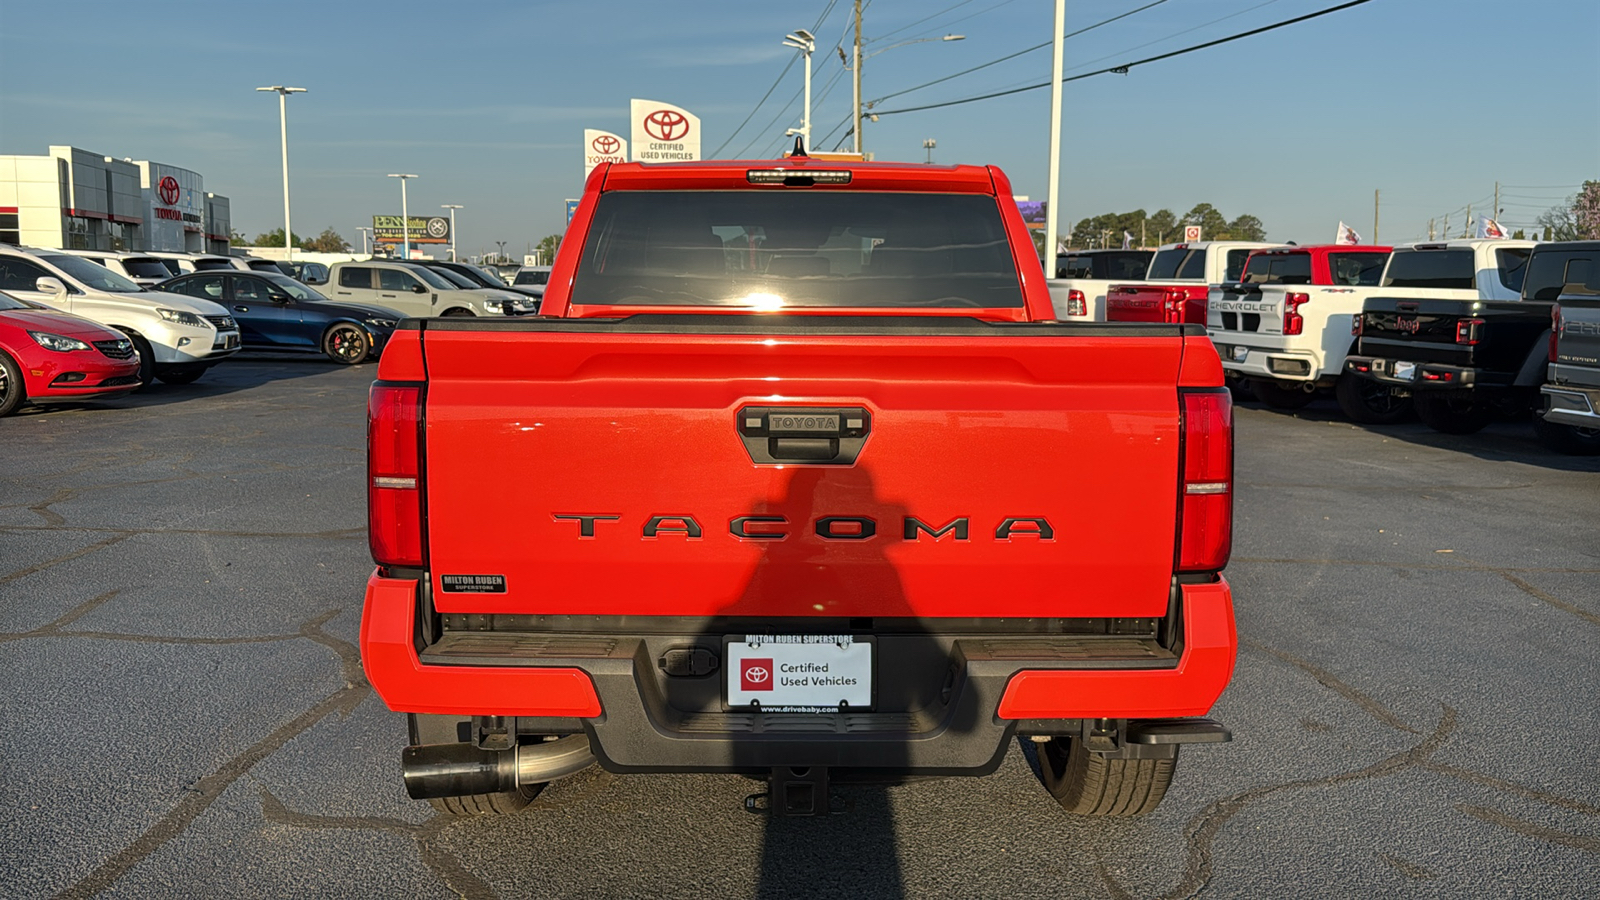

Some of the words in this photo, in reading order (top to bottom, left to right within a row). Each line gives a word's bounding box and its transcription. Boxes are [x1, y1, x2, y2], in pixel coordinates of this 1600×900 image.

[649, 143, 684, 151] CERTIFIED
[154, 207, 183, 221] TOYOTA
[374, 216, 404, 227] PENN
[1209, 301, 1277, 312] CHEVROLET
[1393, 316, 1420, 334] Jeep
[773, 417, 837, 429] TOYOTA
[552, 513, 1056, 541] TACOMA
[443, 576, 474, 585] MILTON
[475, 576, 503, 585] RUBEN
[745, 635, 774, 644] MILTON
[776, 635, 801, 644] RUBEN
[803, 635, 854, 644] SUPERSTORE
[780, 663, 829, 673] Certified
[780, 677, 808, 686] Used
[811, 676, 857, 686] Vehicles
[760, 706, 839, 714] www.drivebaby.com
